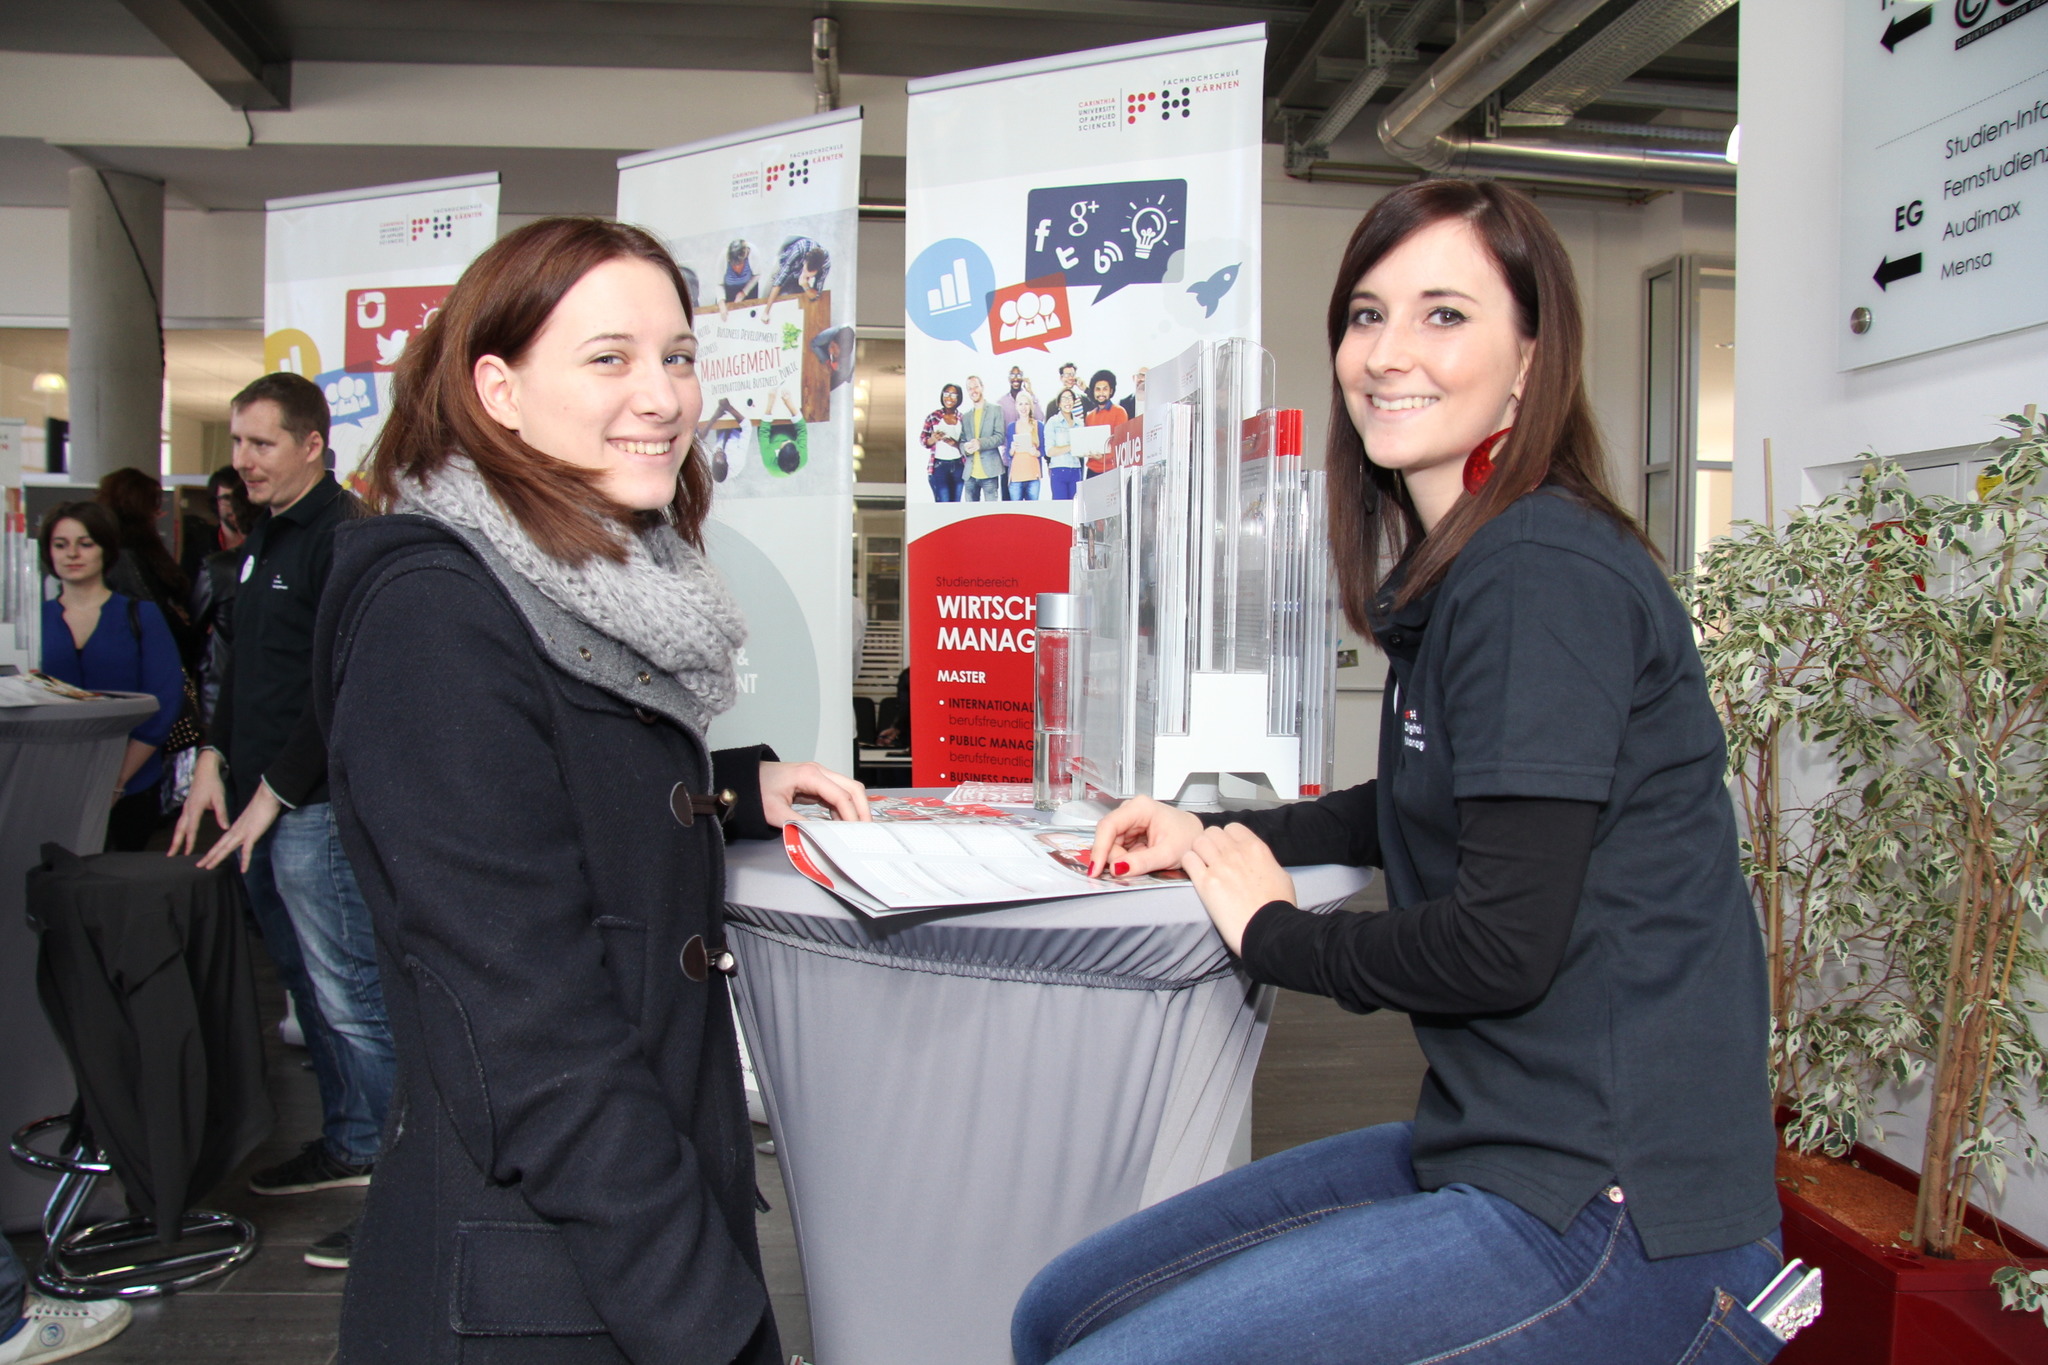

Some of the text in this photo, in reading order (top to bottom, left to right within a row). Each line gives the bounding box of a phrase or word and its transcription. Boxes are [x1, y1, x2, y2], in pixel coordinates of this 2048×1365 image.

[1162, 69, 1240, 86] FACHHOCHSCHULE
[1195, 80, 1240, 94] KÄRNTEN
[1078, 98, 1116, 108] CARINTHIA
[1078, 105, 1116, 116] UNIVERSITY
[1079, 113, 1116, 124] OF APPLIED
[1078, 121, 1116, 132] SCIENCES
[1895, 200, 1924, 232] EG
[1942, 200, 2021, 241] Audimax
[1940, 252, 1993, 280] Mensa
[700, 346, 781, 383] MANAGEMENT
[778, 360, 799, 380] PUBLIC
[1115, 431, 1142, 468] value
[936, 576, 1019, 588] Studienbereich
[937, 626, 1036, 654] MANAG
[937, 669, 986, 684] MASTER
[949, 698, 1034, 713] INTERNATIONAL
[949, 735, 986, 747] PUBLIC
